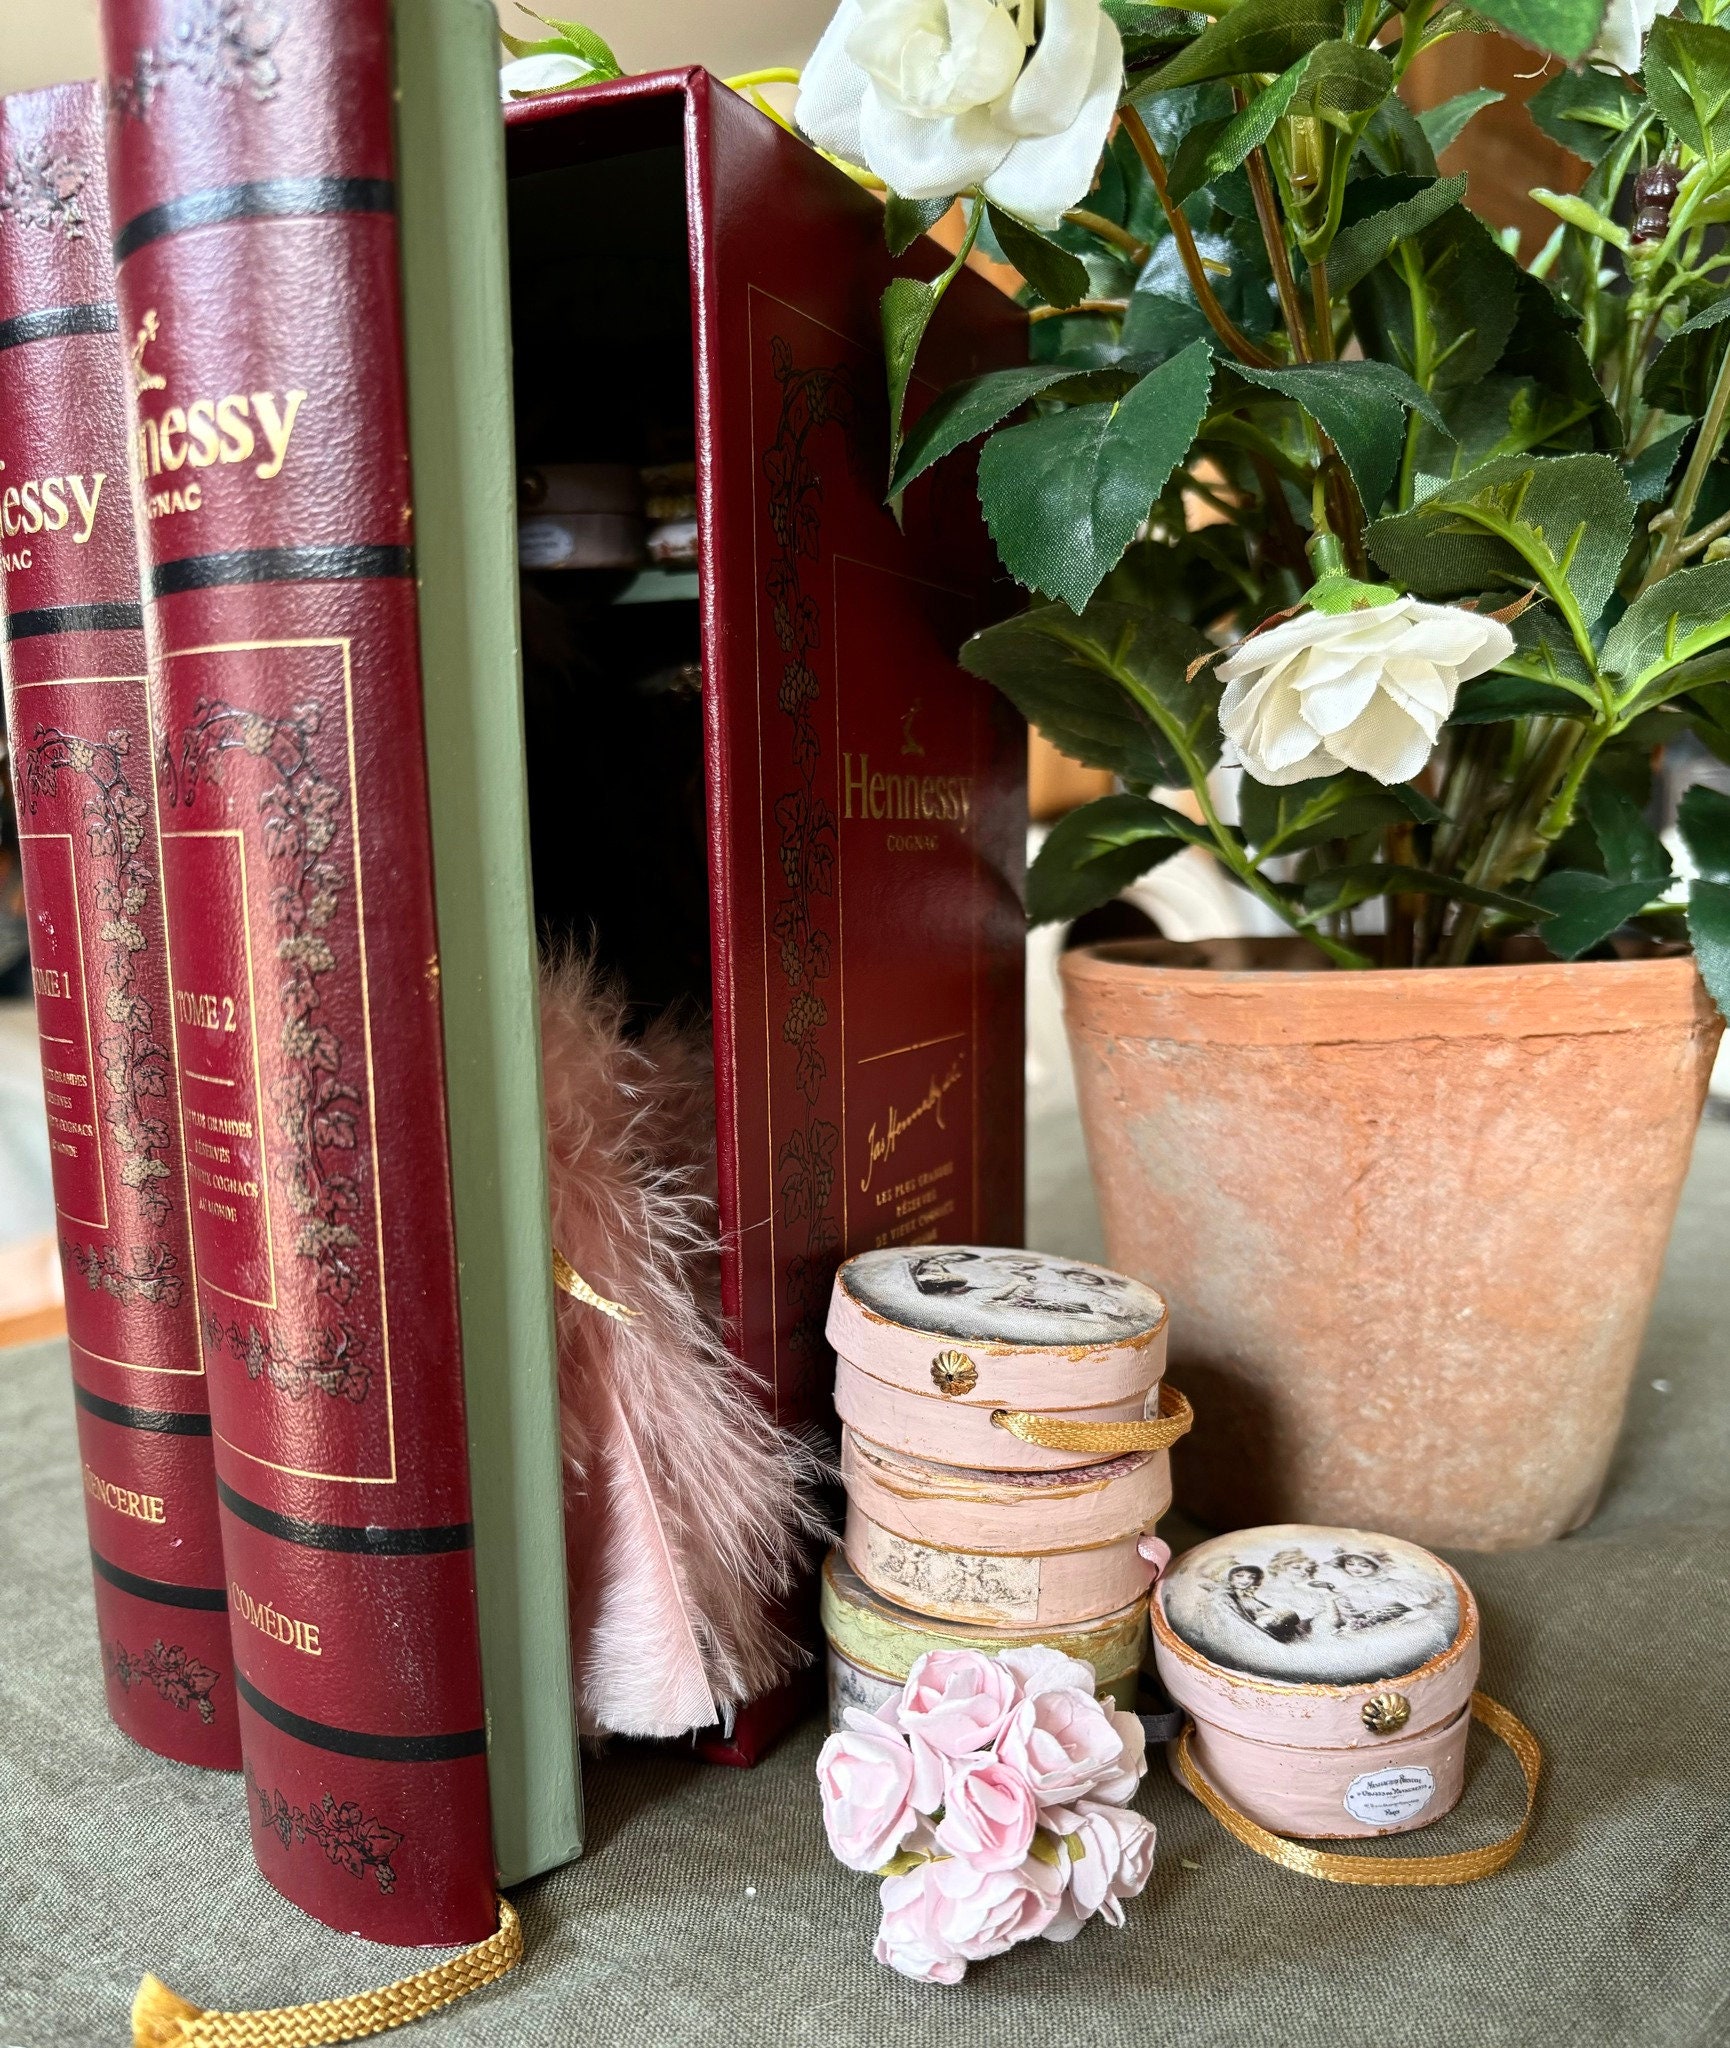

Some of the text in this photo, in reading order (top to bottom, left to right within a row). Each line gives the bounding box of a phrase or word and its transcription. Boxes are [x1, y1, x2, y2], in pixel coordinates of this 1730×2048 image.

[0, 472, 108, 543] essy
[842, 752, 973, 834] Hennessy
[62, 971, 72, 999] 1
[176, 990, 237, 1033] TOME 2
[212, 1174, 259, 1199] COGNACS
[231, 1581, 322, 1656] COMÉDIE
